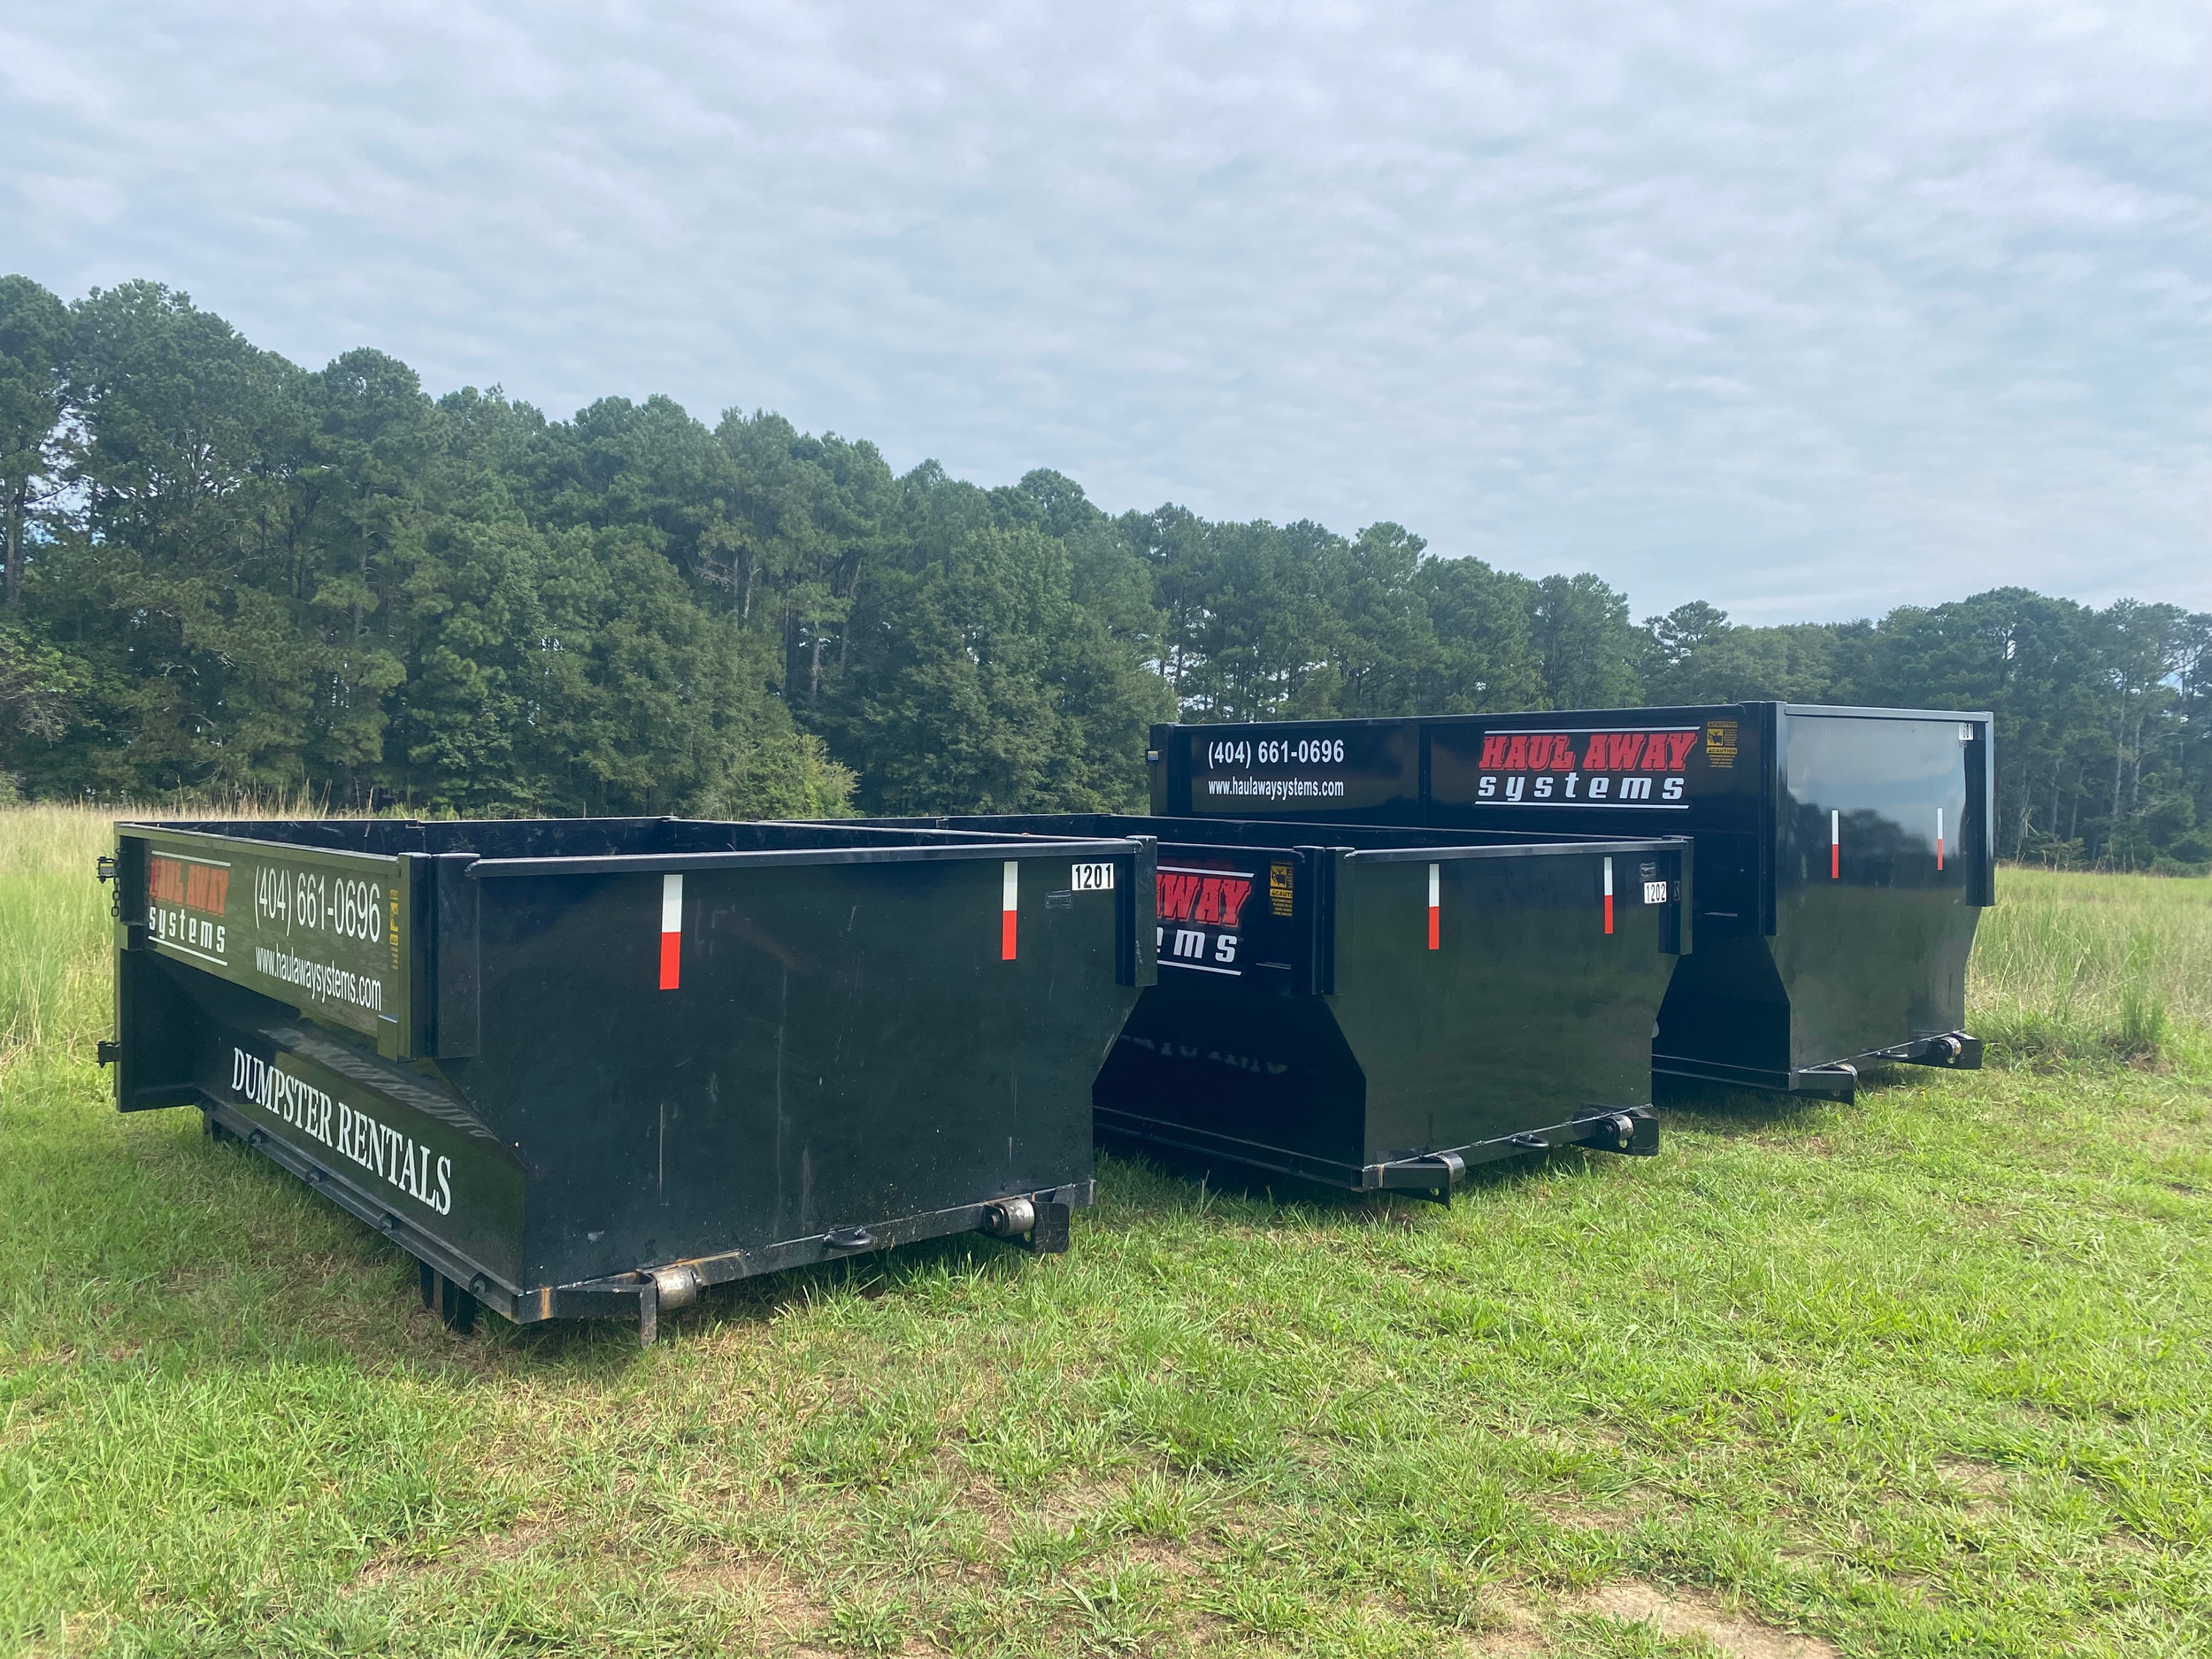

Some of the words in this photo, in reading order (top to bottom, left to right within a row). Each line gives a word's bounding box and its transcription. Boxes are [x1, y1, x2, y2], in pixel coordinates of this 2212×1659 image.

[1208, 741, 1251, 770] (404)
[1257, 740, 1344, 764] 661-0696
[1479, 735, 1576, 772] HAUL
[1582, 733, 1697, 772] AWAY
[1208, 776, 1344, 801] www.haulawaysystems.com
[1478, 772, 1686, 802] systems
[186, 864, 229, 918] AWAY
[1075, 864, 1111, 889] 1201
[1647, 883, 1666, 902] 1202
[255, 865, 292, 937] (404)
[297, 872, 380, 943] 661-0696
[149, 906, 226, 953] systems
[255, 942, 381, 1011] www.haulawaysystems.com
[232, 1047, 333, 1148] DUMPSTER
[336, 1102, 451, 1216] RENTALS
